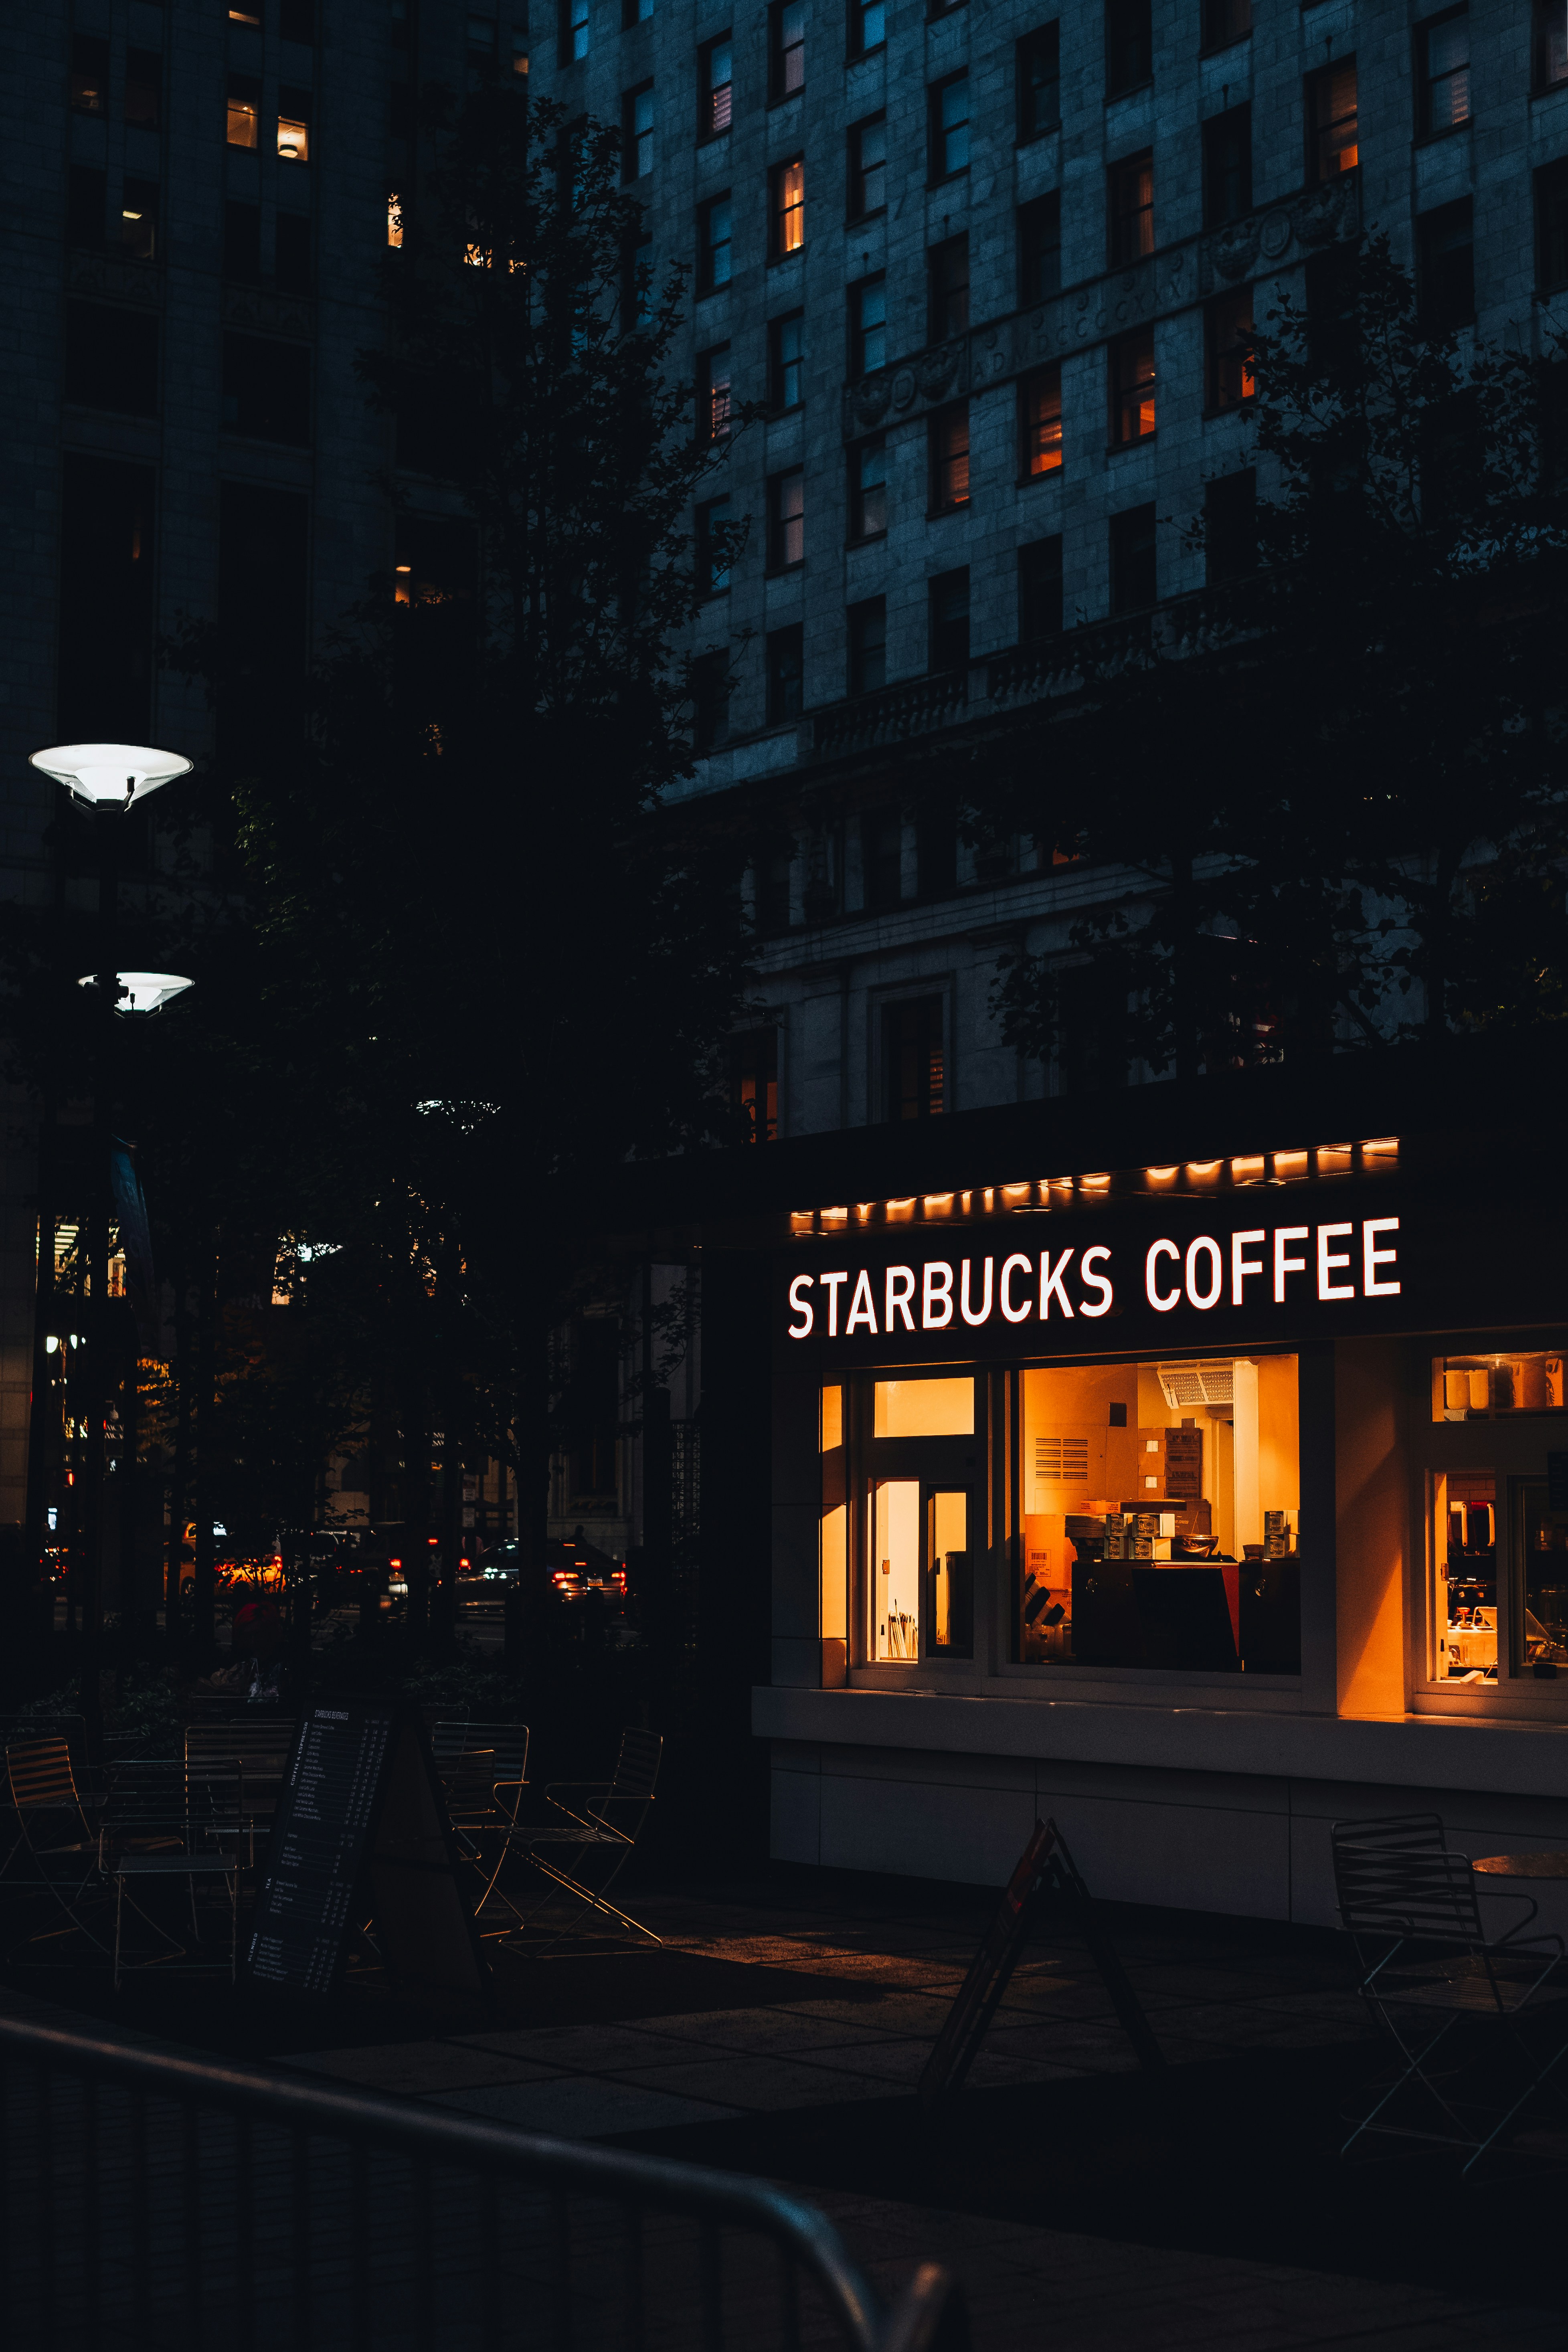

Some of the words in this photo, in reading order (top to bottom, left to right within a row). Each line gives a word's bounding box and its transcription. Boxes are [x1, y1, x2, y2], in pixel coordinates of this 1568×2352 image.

[789, 1247, 1112, 1338] STARBUCKS
[1147, 1218, 1400, 1310] COFFEE
[291, 1762, 299, 1785] COFFEE
[298, 1722, 308, 1753] ESPRESSO
[247, 1933, 258, 1962] BLENDED
